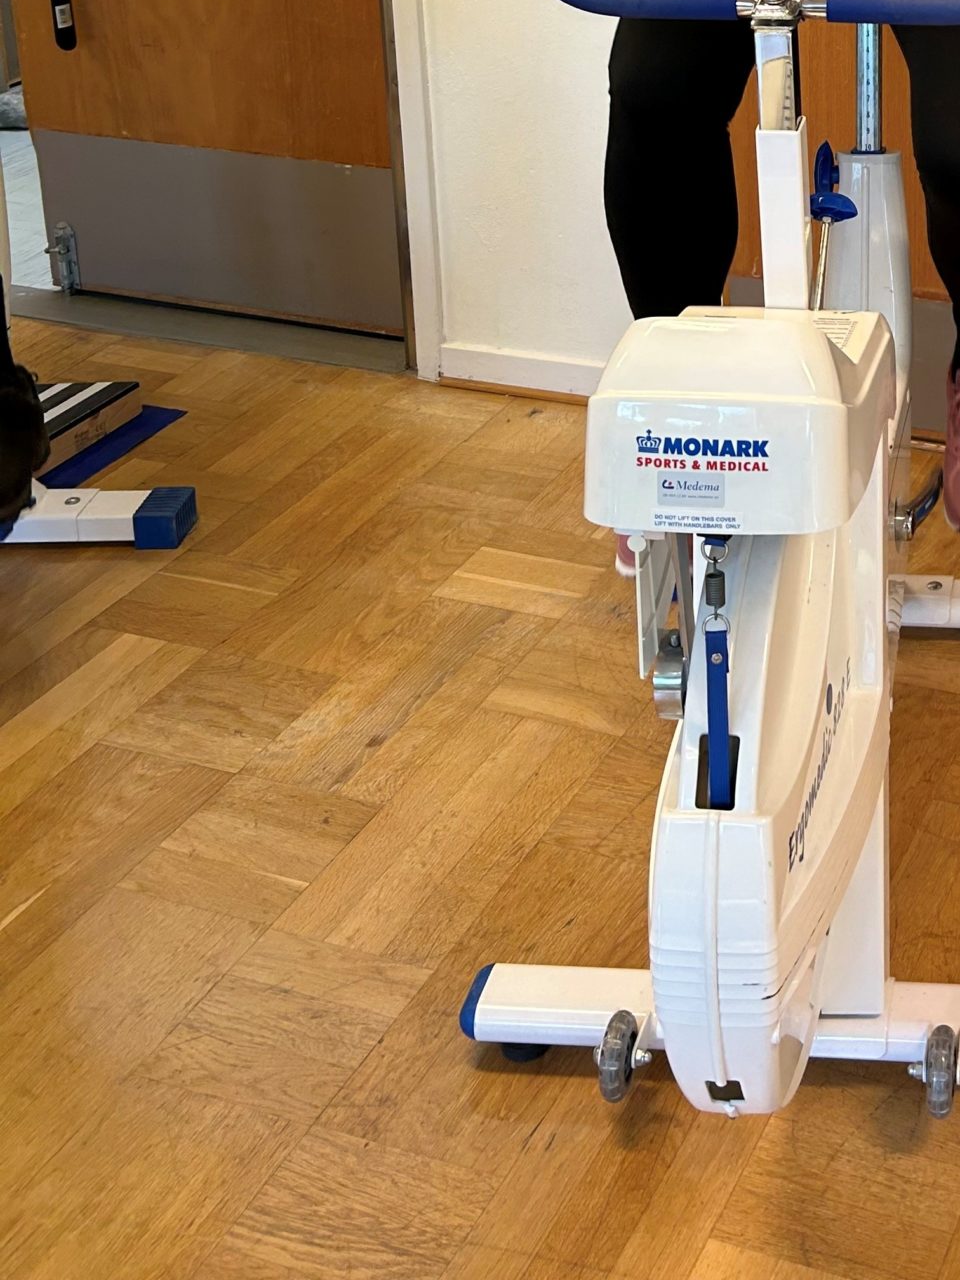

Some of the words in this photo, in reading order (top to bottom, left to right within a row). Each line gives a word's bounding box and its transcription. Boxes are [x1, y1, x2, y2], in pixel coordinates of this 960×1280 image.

[663, 437, 769, 458] MONARK
[636, 457, 686, 470] SPORTS
[691, 459, 701, 470] &
[706, 461, 768, 472] MEDICAL
[676, 480, 720, 492] Medema
[789, 726, 832, 872] Ergomedic
